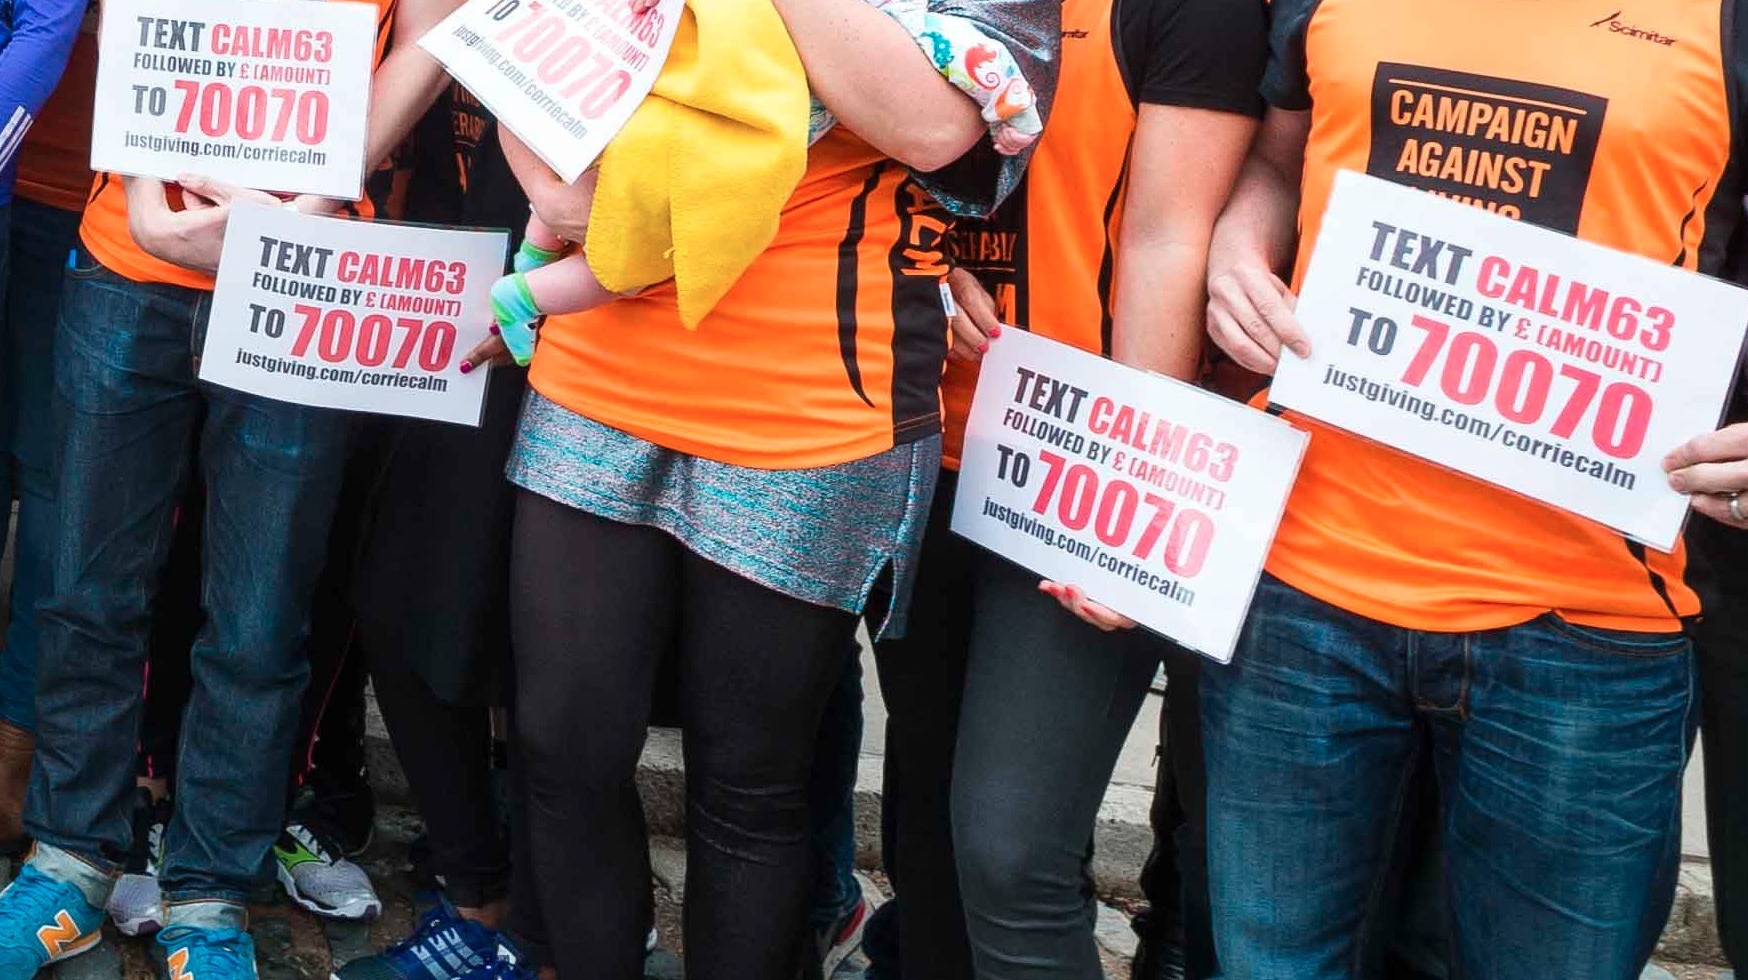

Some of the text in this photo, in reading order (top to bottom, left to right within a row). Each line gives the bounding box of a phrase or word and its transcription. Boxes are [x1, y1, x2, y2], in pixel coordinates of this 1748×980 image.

[133, 52, 212, 76] FOLLOWED
[215, 60, 236, 79] BY
[137, 15, 333, 64] TEXT CALM63
[1609, 21, 1677, 47] Scimitar
[131, 79, 329, 146] TO 70070
[1390, 89, 1578, 155] CAMPAIGN
[125, 130, 327, 166] justgiving.com/corriecalm
[1396, 138, 1551, 199] AGAINST
[252, 271, 337, 303] FOLLOWED
[339, 288, 363, 306] BY
[259, 235, 467, 295] TEXT CALM63
[1369, 220, 1676, 352] TEXT CALM63
[1356, 266, 1474, 321] FOLLOWED
[1477, 305, 1513, 332] BY
[235, 348, 448, 393] justgiving.com/corriecalm
[249, 302, 457, 373] TO 70070
[1346, 306, 1653, 460] TO 70070
[1002, 407, 1085, 455] FOLLOWED
[1085, 440, 1113, 465] BY
[1013, 366, 1238, 482] TEXT CALM63
[1322, 363, 1636, 491] justgiving.com/corriecalm
[996, 443, 1207, 575] TO 70070
[982, 496, 1195, 607] justgiving.com/corriecalm
